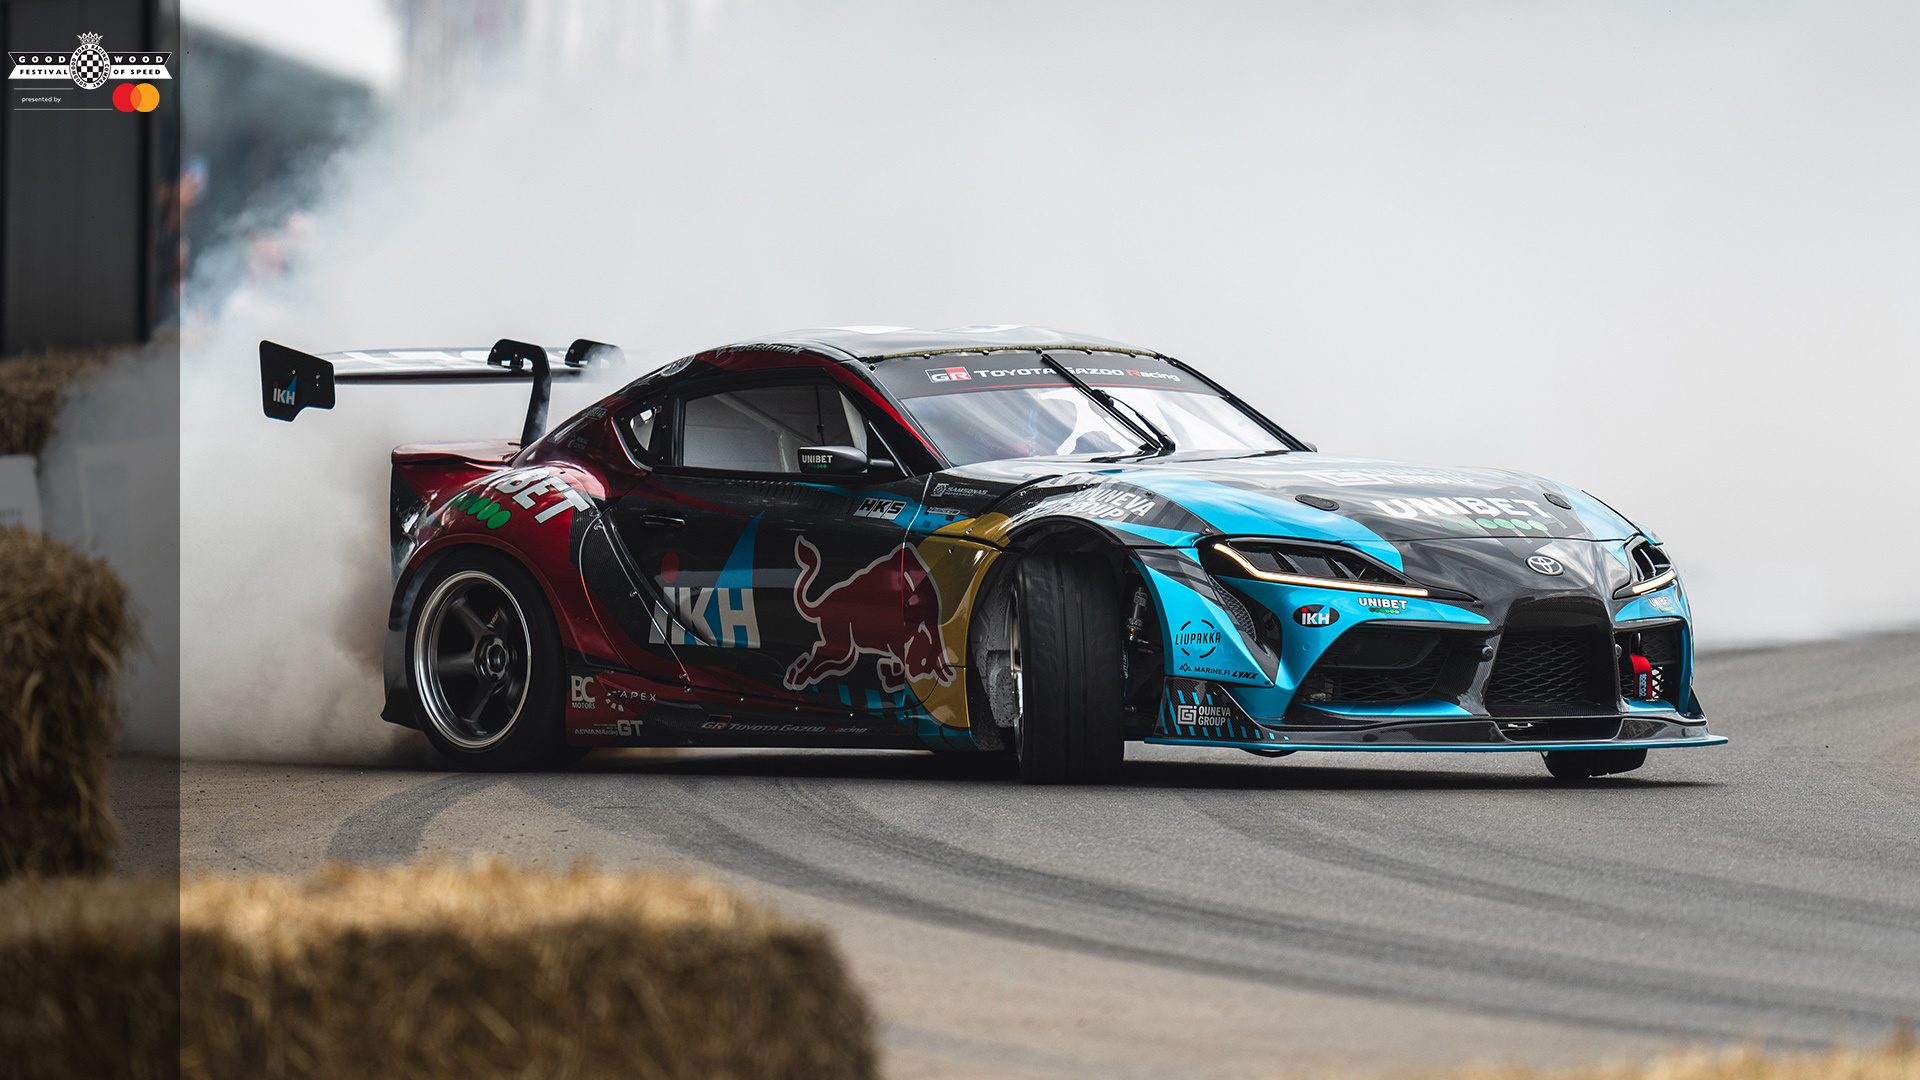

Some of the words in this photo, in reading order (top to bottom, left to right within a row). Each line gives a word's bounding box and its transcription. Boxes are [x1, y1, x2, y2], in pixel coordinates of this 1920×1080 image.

[929, 369, 971, 382] GR
[1126, 369, 1181, 382] Racing
[801, 454, 833, 464] UNIBET
[860, 498, 906, 515] HKS
[1369, 496, 1552, 520] UNIBET
[1357, 597, 1408, 610] UNIBET
[1175, 631, 1221, 645] LIUPAKKA
[1193, 665, 1231, 676] MARINE.FI
[1231, 670, 1259, 680] LYNX
[571, 675, 596, 703] BC
[620, 690, 657, 701] APEX
[571, 702, 596, 710] MOTORS
[1198, 705, 1231, 717] OUNEVA
[701, 721, 727, 730] GR
[729, 722, 778, 731] TOYOTA
[779, 724, 826, 733] GAZOO
[1198, 715, 1226, 727] GROUP
[617, 719, 643, 737] GT
